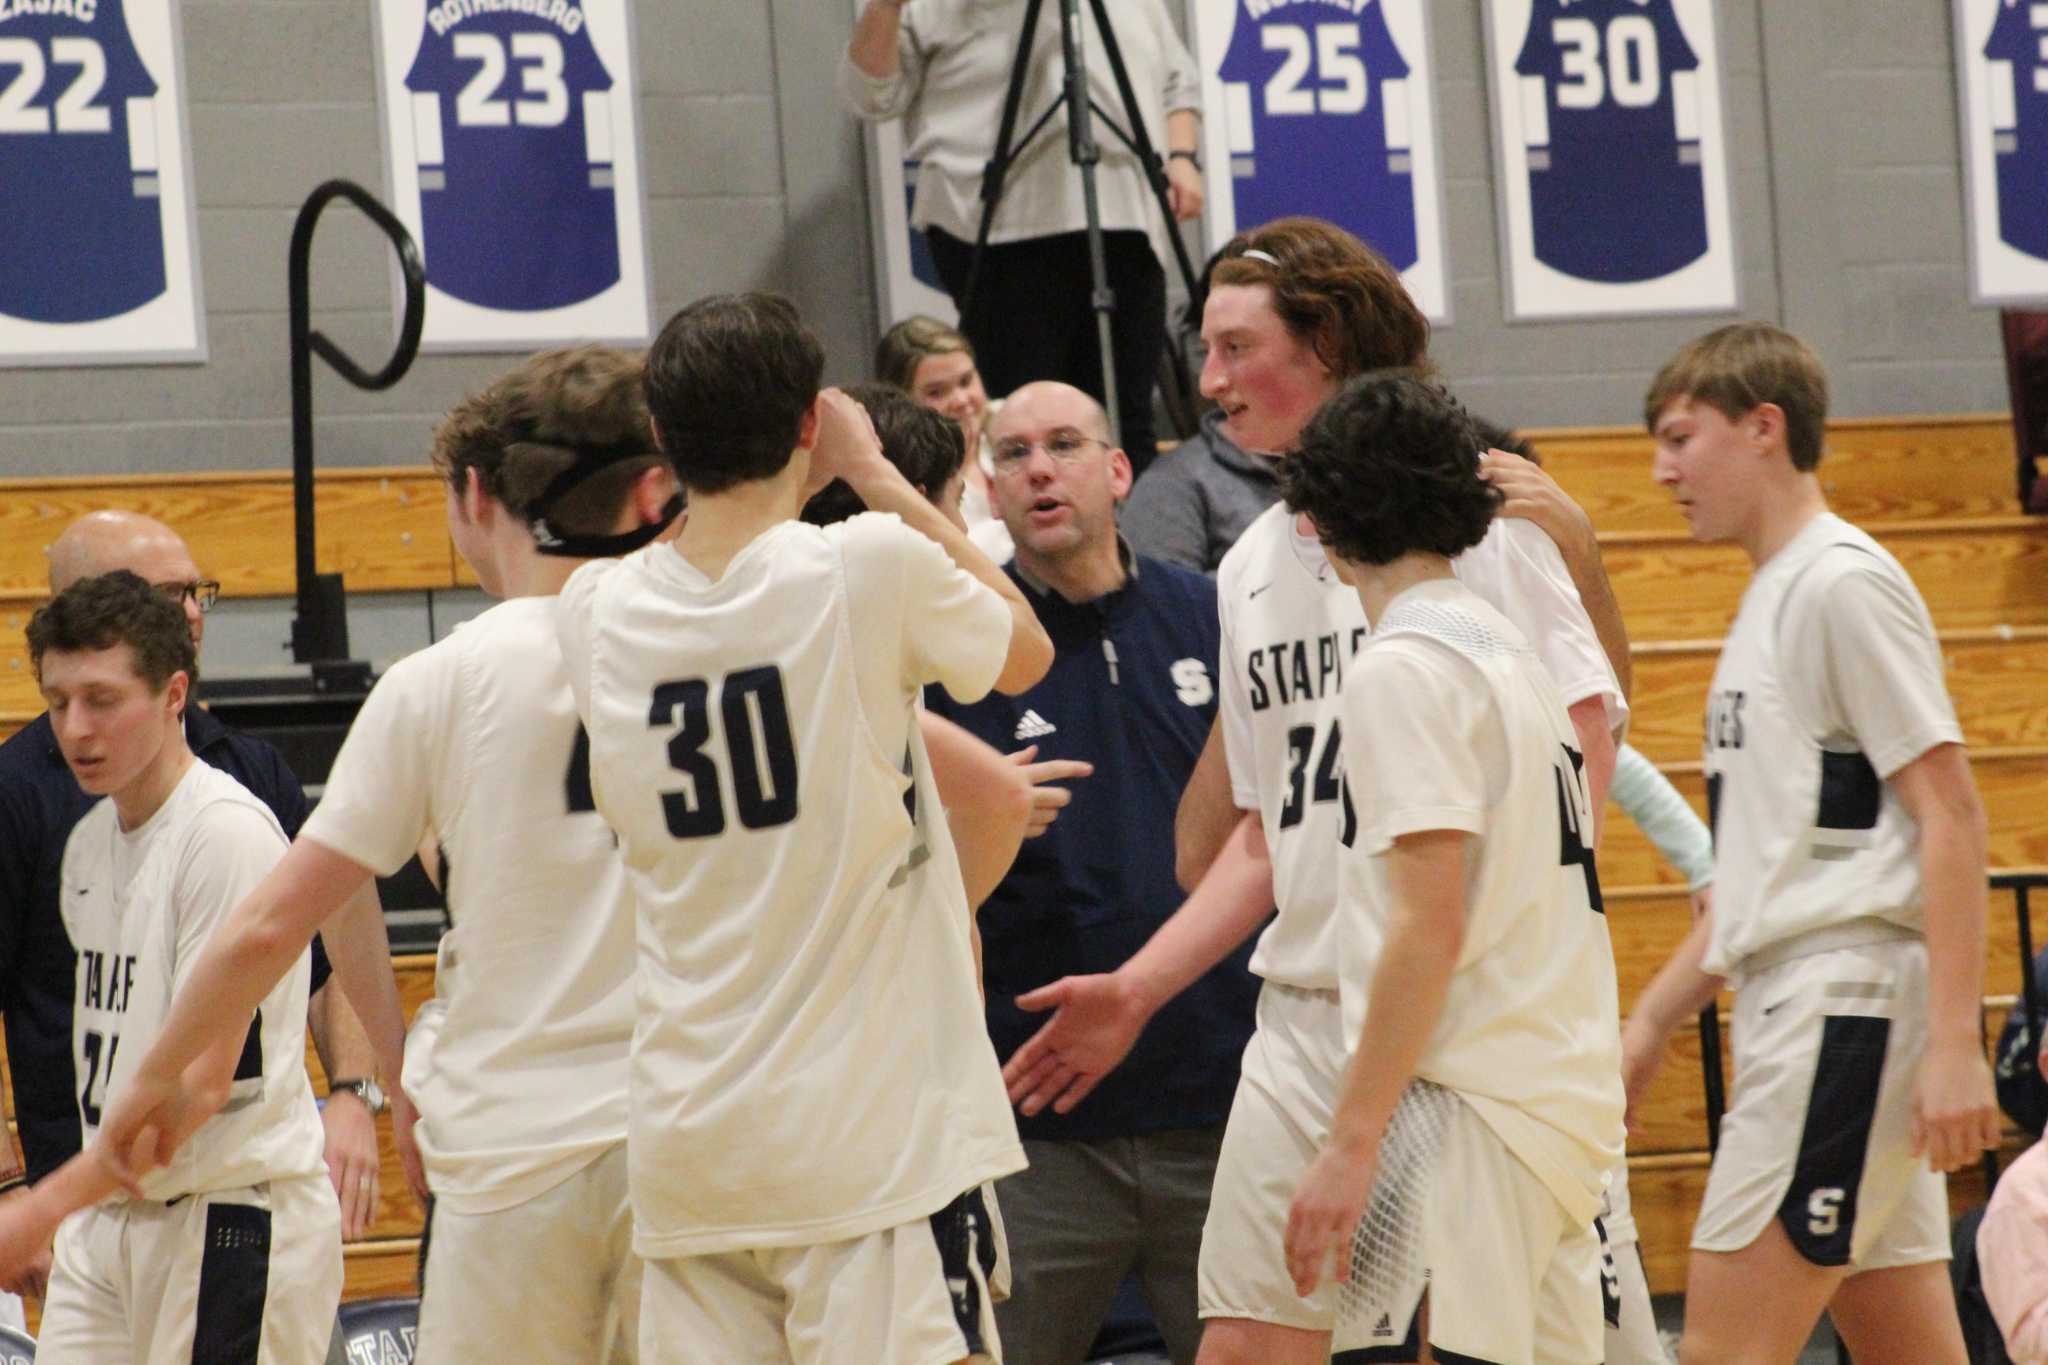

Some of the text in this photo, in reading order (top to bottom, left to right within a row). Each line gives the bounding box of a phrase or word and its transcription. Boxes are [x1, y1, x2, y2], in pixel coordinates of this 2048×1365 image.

[0, 36, 112, 134] 22
[453, 32, 569, 127] 23
[1261, 23, 1368, 115] 25
[1552, 15, 1660, 109] 30
[1169, 657, 1214, 707] S
[648, 664, 799, 838] 30
[1808, 1187, 1845, 1236] S
